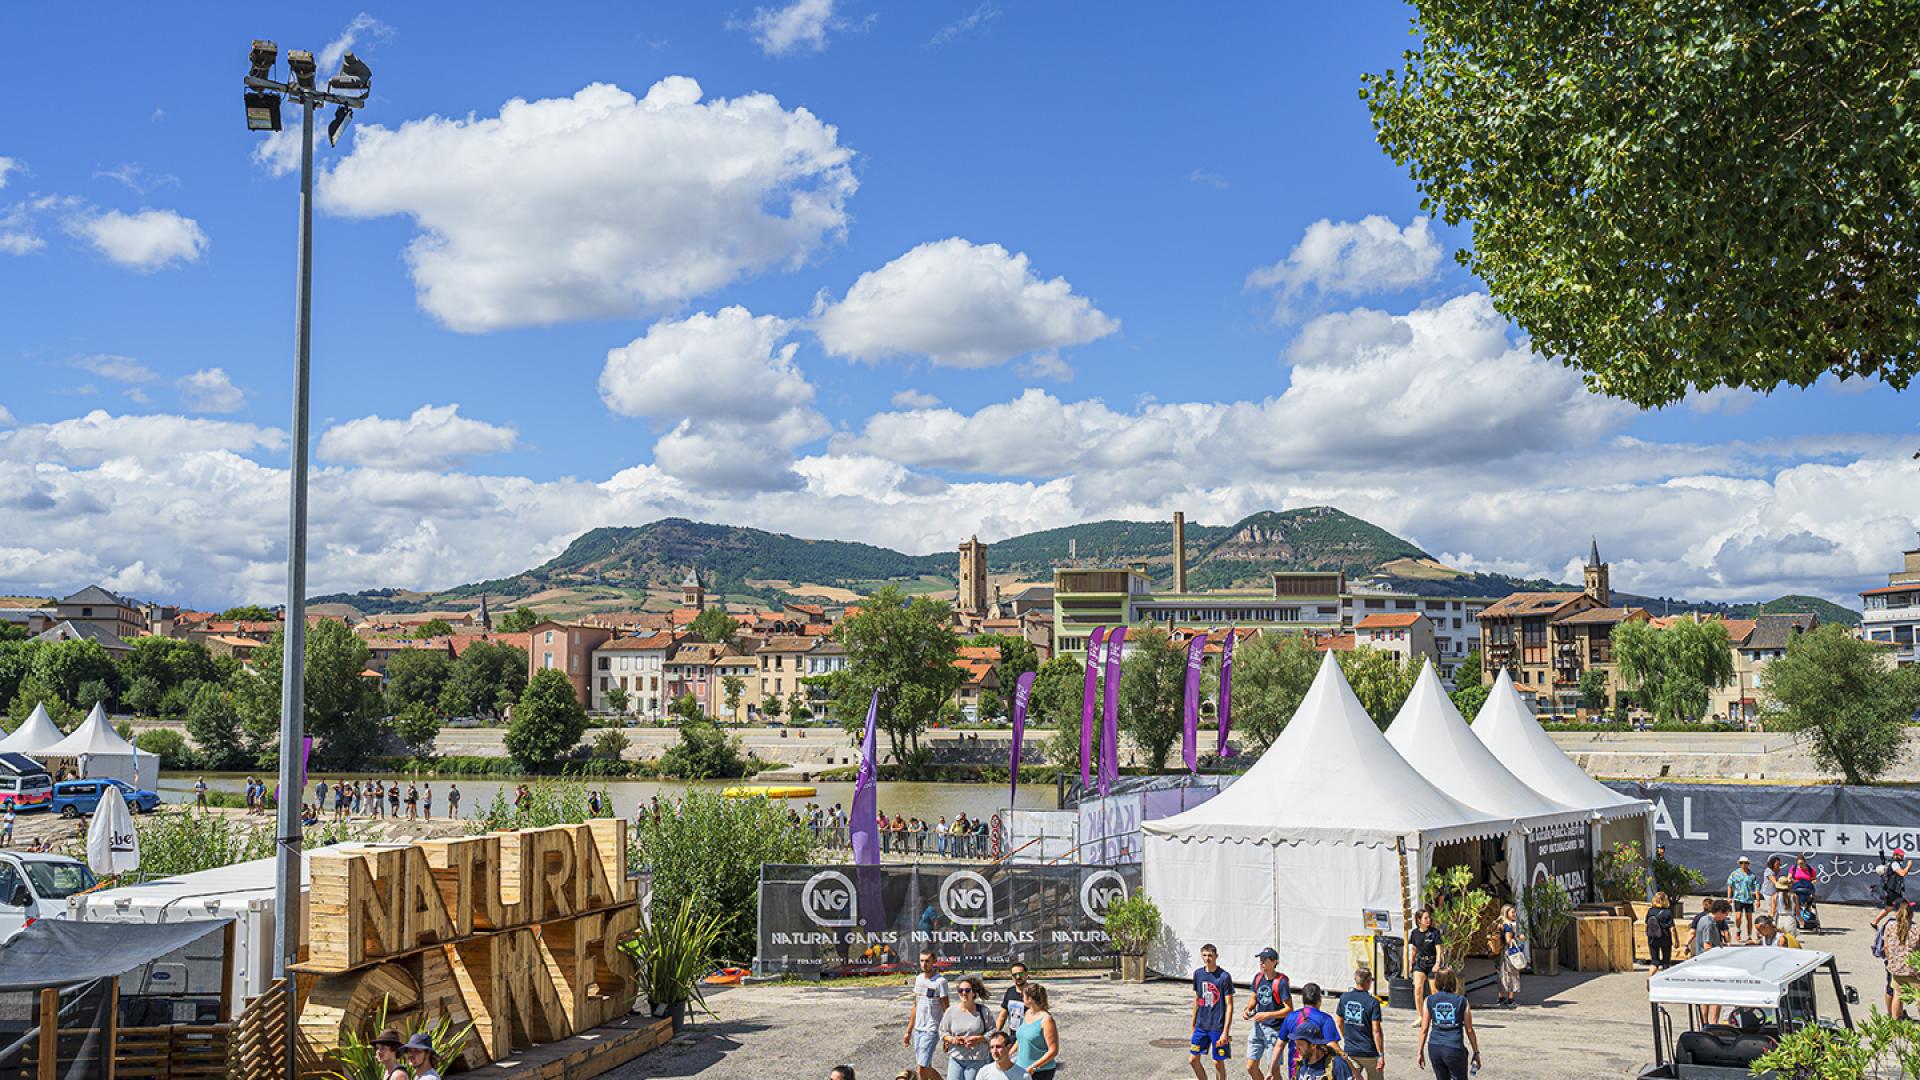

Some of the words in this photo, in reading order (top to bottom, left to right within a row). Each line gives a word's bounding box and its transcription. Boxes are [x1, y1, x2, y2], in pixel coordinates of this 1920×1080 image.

[1753, 827, 1825, 847] SPORT
[310, 819, 638, 970] NATURAL
[812, 889, 849, 911] NG
[950, 888, 985, 909] NG
[771, 931, 840, 945] NATURAL
[844, 931, 897, 944] GAMES
[911, 931, 977, 943] NATURAL
[982, 931, 1034, 942] GAMES
[299, 903, 639, 1074] GAMES
